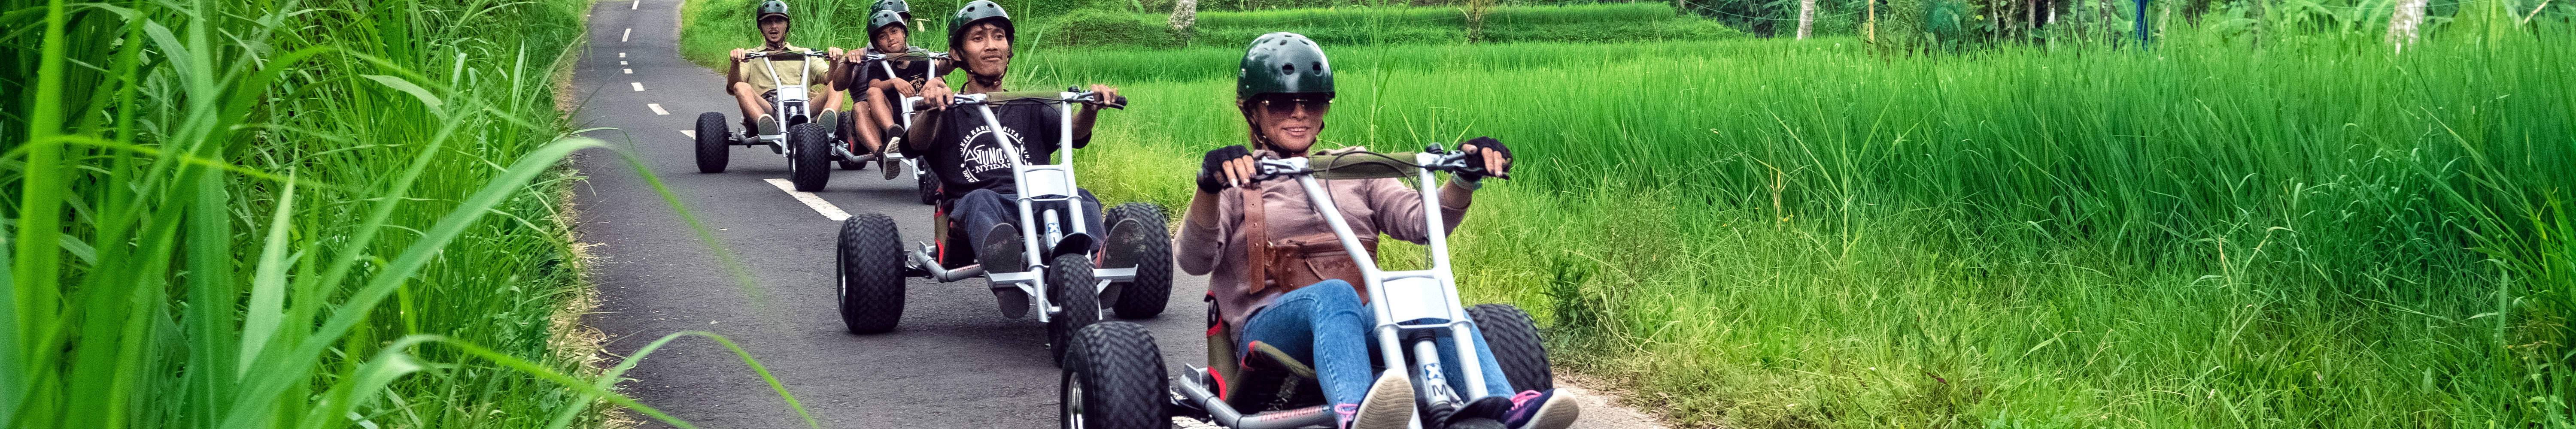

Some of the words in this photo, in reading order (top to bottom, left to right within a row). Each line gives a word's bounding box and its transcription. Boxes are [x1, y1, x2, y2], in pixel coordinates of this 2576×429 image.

[960, 134, 971, 157] UKAN
[970, 125, 990, 135] KARE
[1003, 126, 1019, 138] KITA
[962, 169, 971, 179] TAPI
[1432, 384, 1448, 396] M
